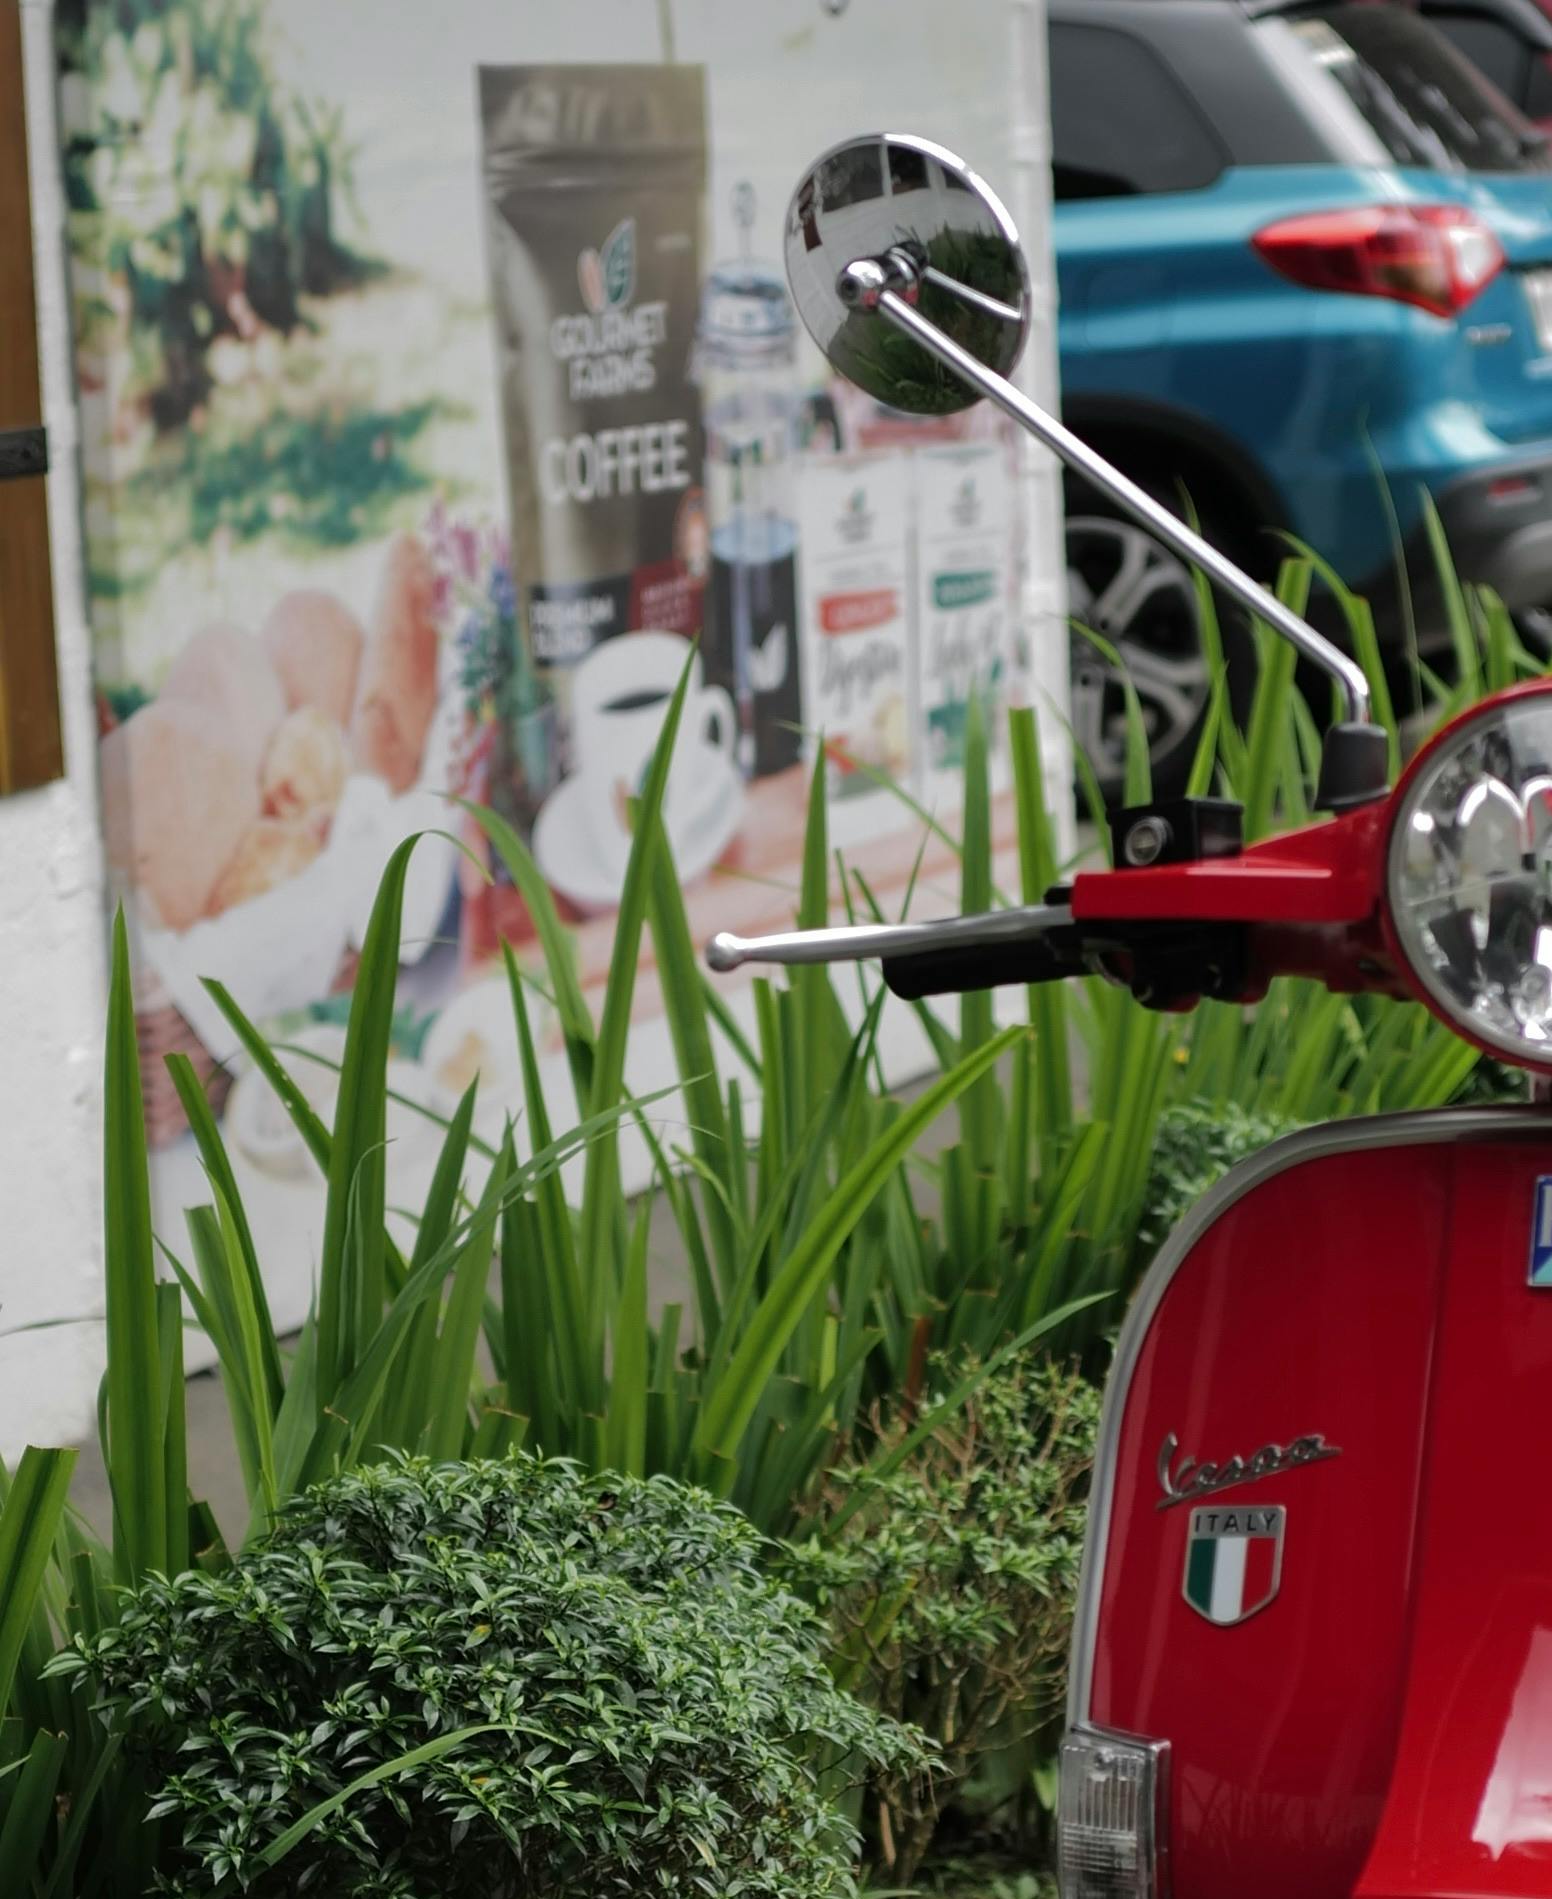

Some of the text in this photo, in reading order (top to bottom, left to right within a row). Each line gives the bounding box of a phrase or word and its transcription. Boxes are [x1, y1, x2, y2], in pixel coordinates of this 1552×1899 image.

[540, 418, 691, 505] COFFEE
[1155, 1431, 1344, 1511] Vespa
[1195, 1513, 1277, 1533] ITALY
